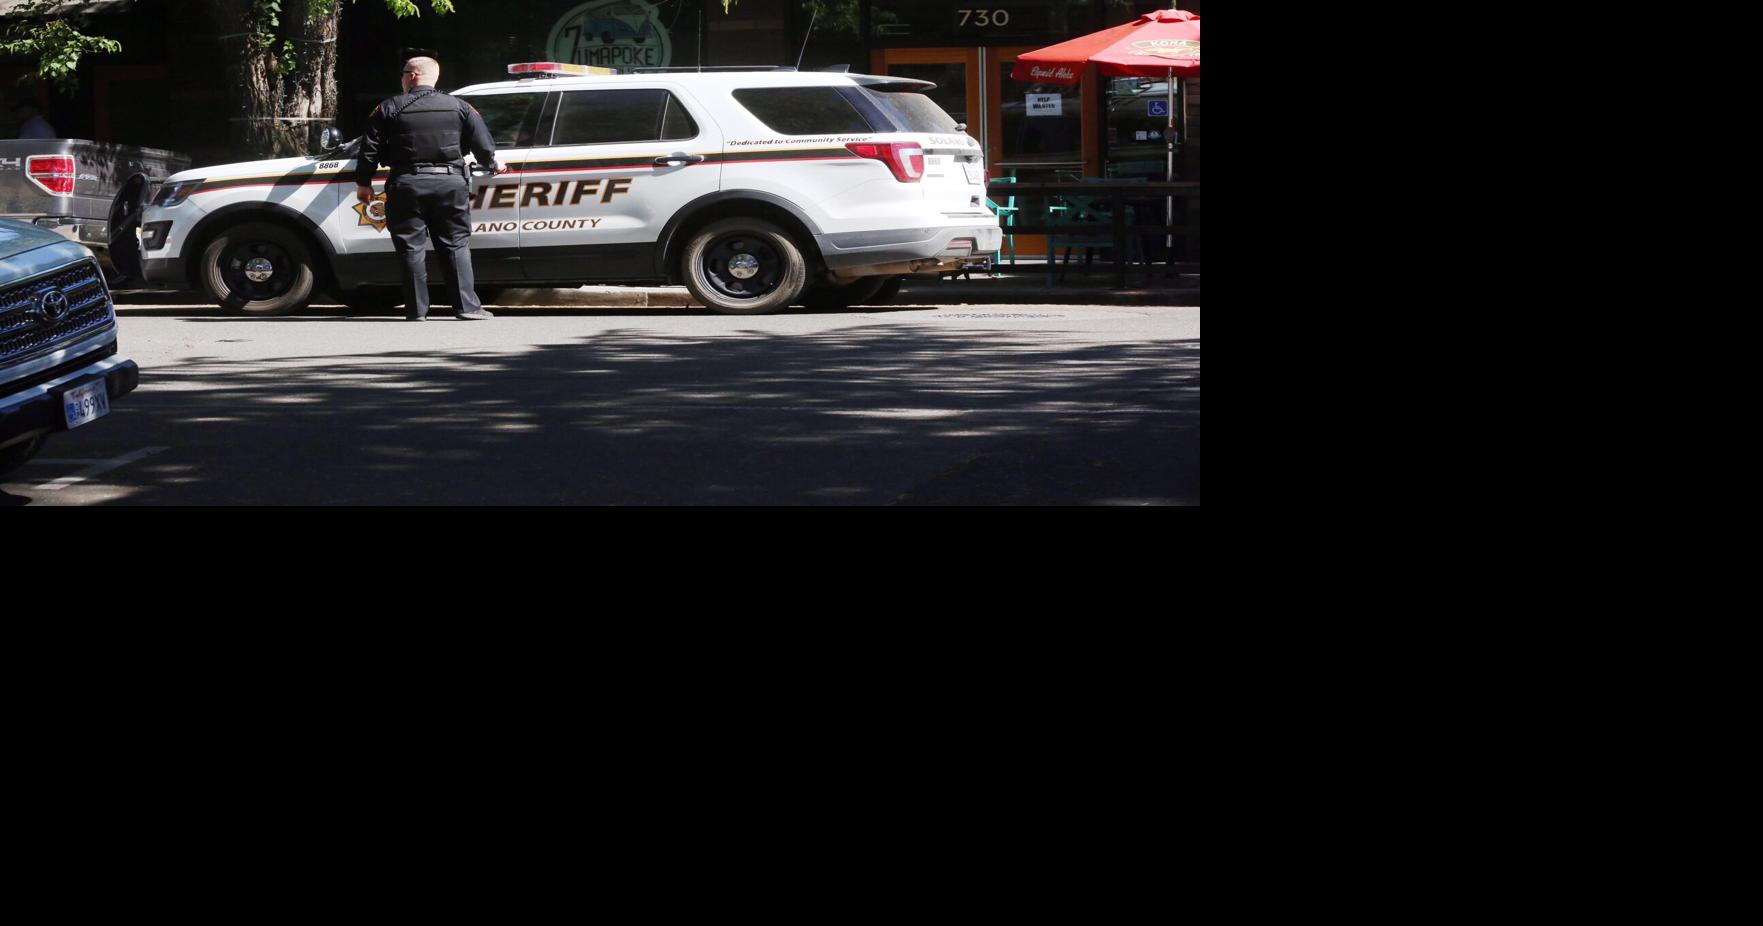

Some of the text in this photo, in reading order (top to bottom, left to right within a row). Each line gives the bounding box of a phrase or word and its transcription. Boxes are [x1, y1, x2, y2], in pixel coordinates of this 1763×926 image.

[957, 9, 1009, 27] 730
[785, 136, 834, 145] Community
[470, 177, 633, 211] HERIFF
[522, 217, 602, 232] COUNTY
